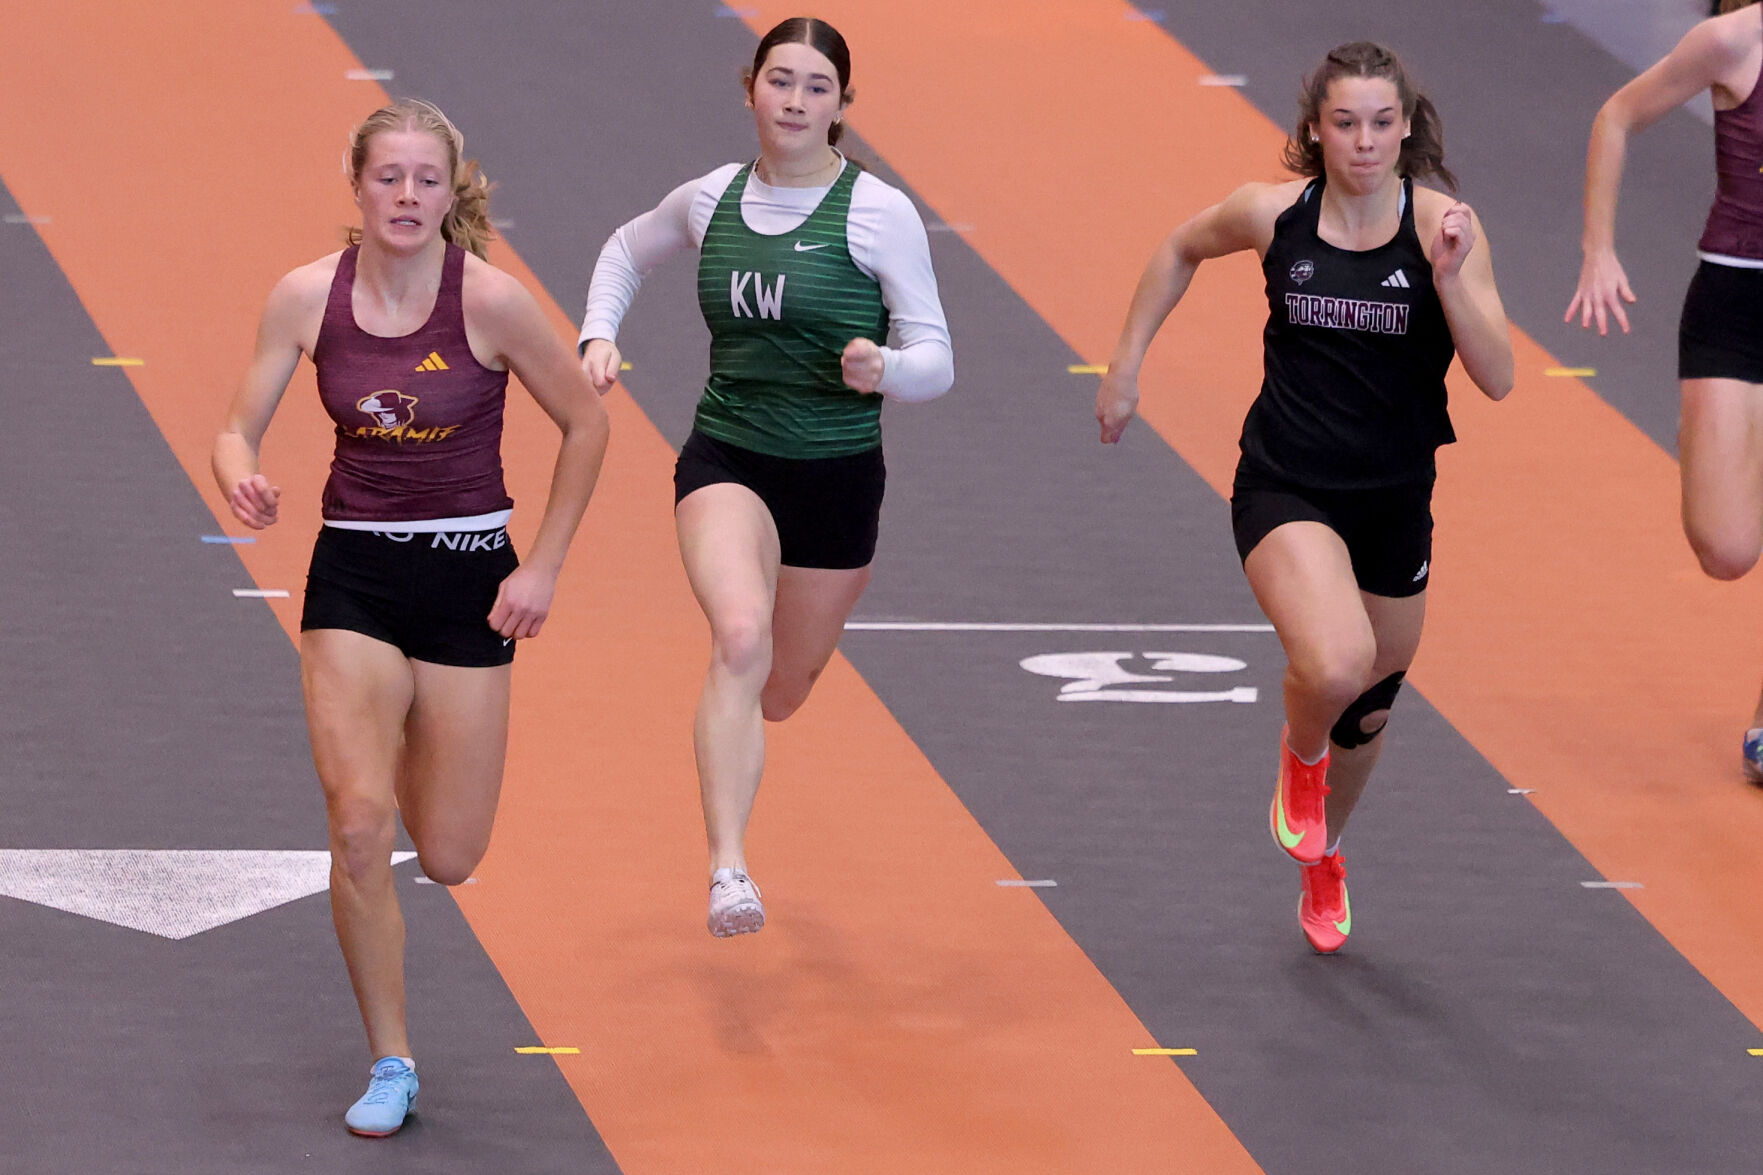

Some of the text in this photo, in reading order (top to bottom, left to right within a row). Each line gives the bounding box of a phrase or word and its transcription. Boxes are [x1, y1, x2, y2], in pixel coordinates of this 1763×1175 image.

[731, 270, 786, 320] KW
[1285, 293, 1409, 335] TORRINGTON
[431, 529, 506, 551] NIKE
